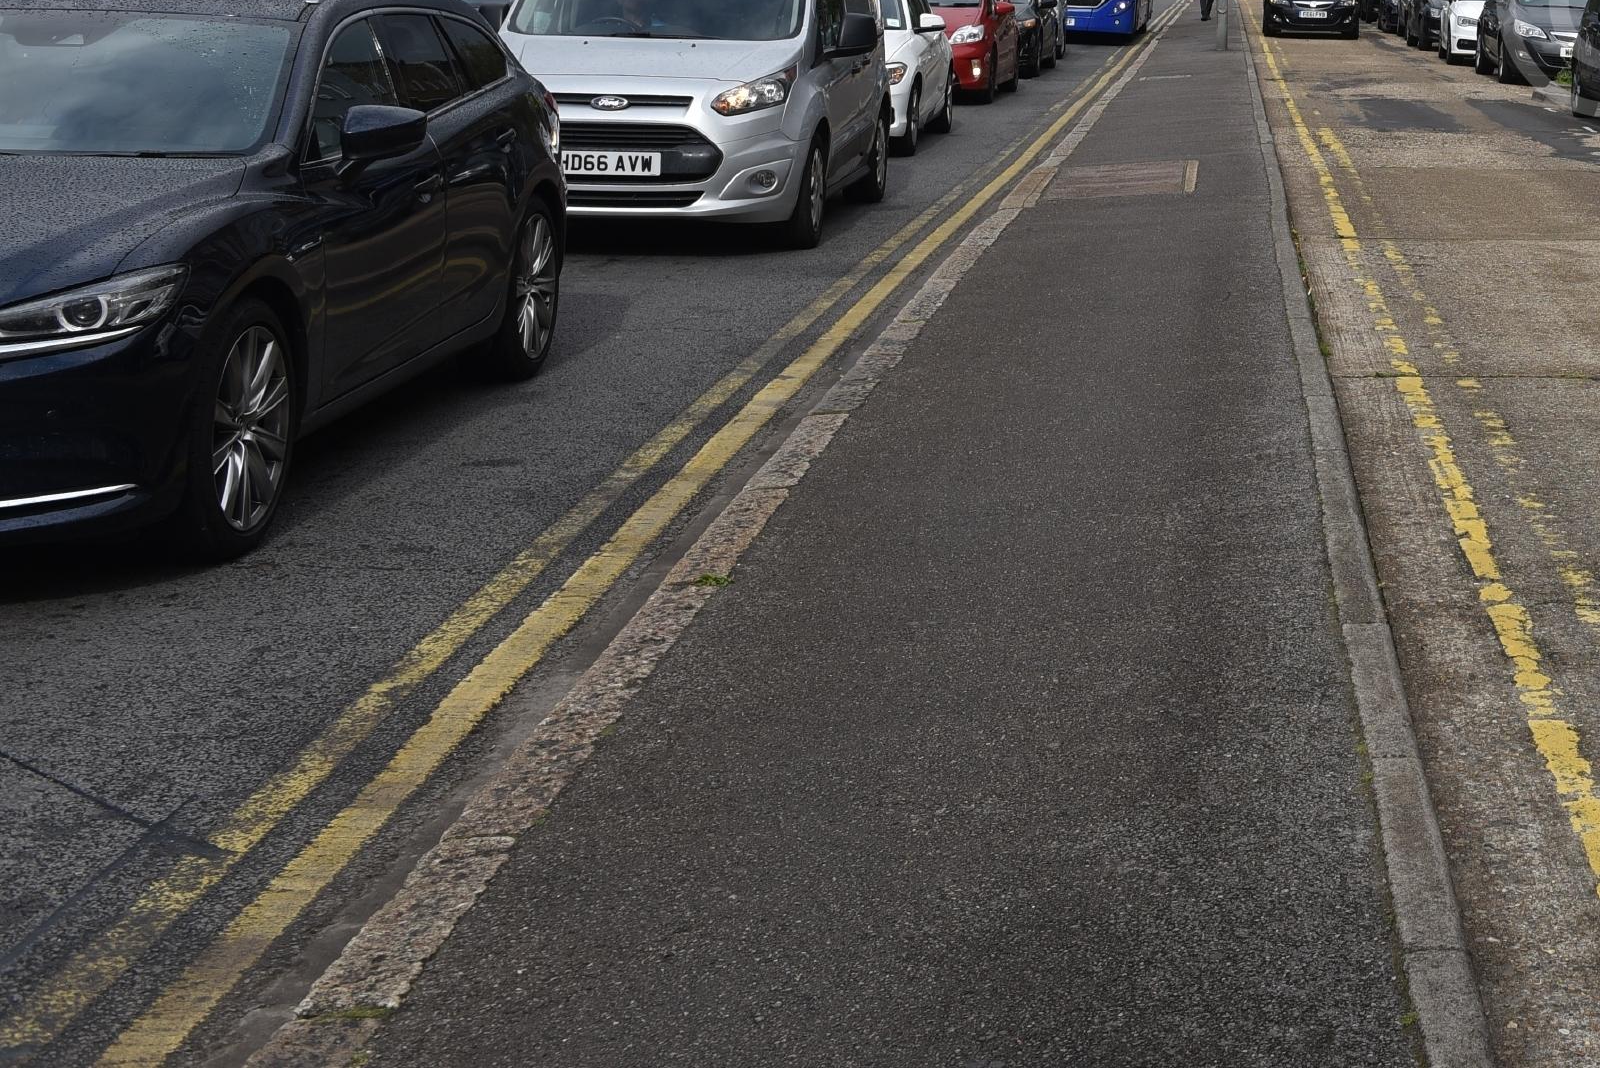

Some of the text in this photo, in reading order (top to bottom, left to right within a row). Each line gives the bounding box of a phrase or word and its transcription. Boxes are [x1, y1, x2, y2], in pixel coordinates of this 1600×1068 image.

[598, 96, 620, 108] Ford
[562, 154, 653, 172] HD66 AVW
